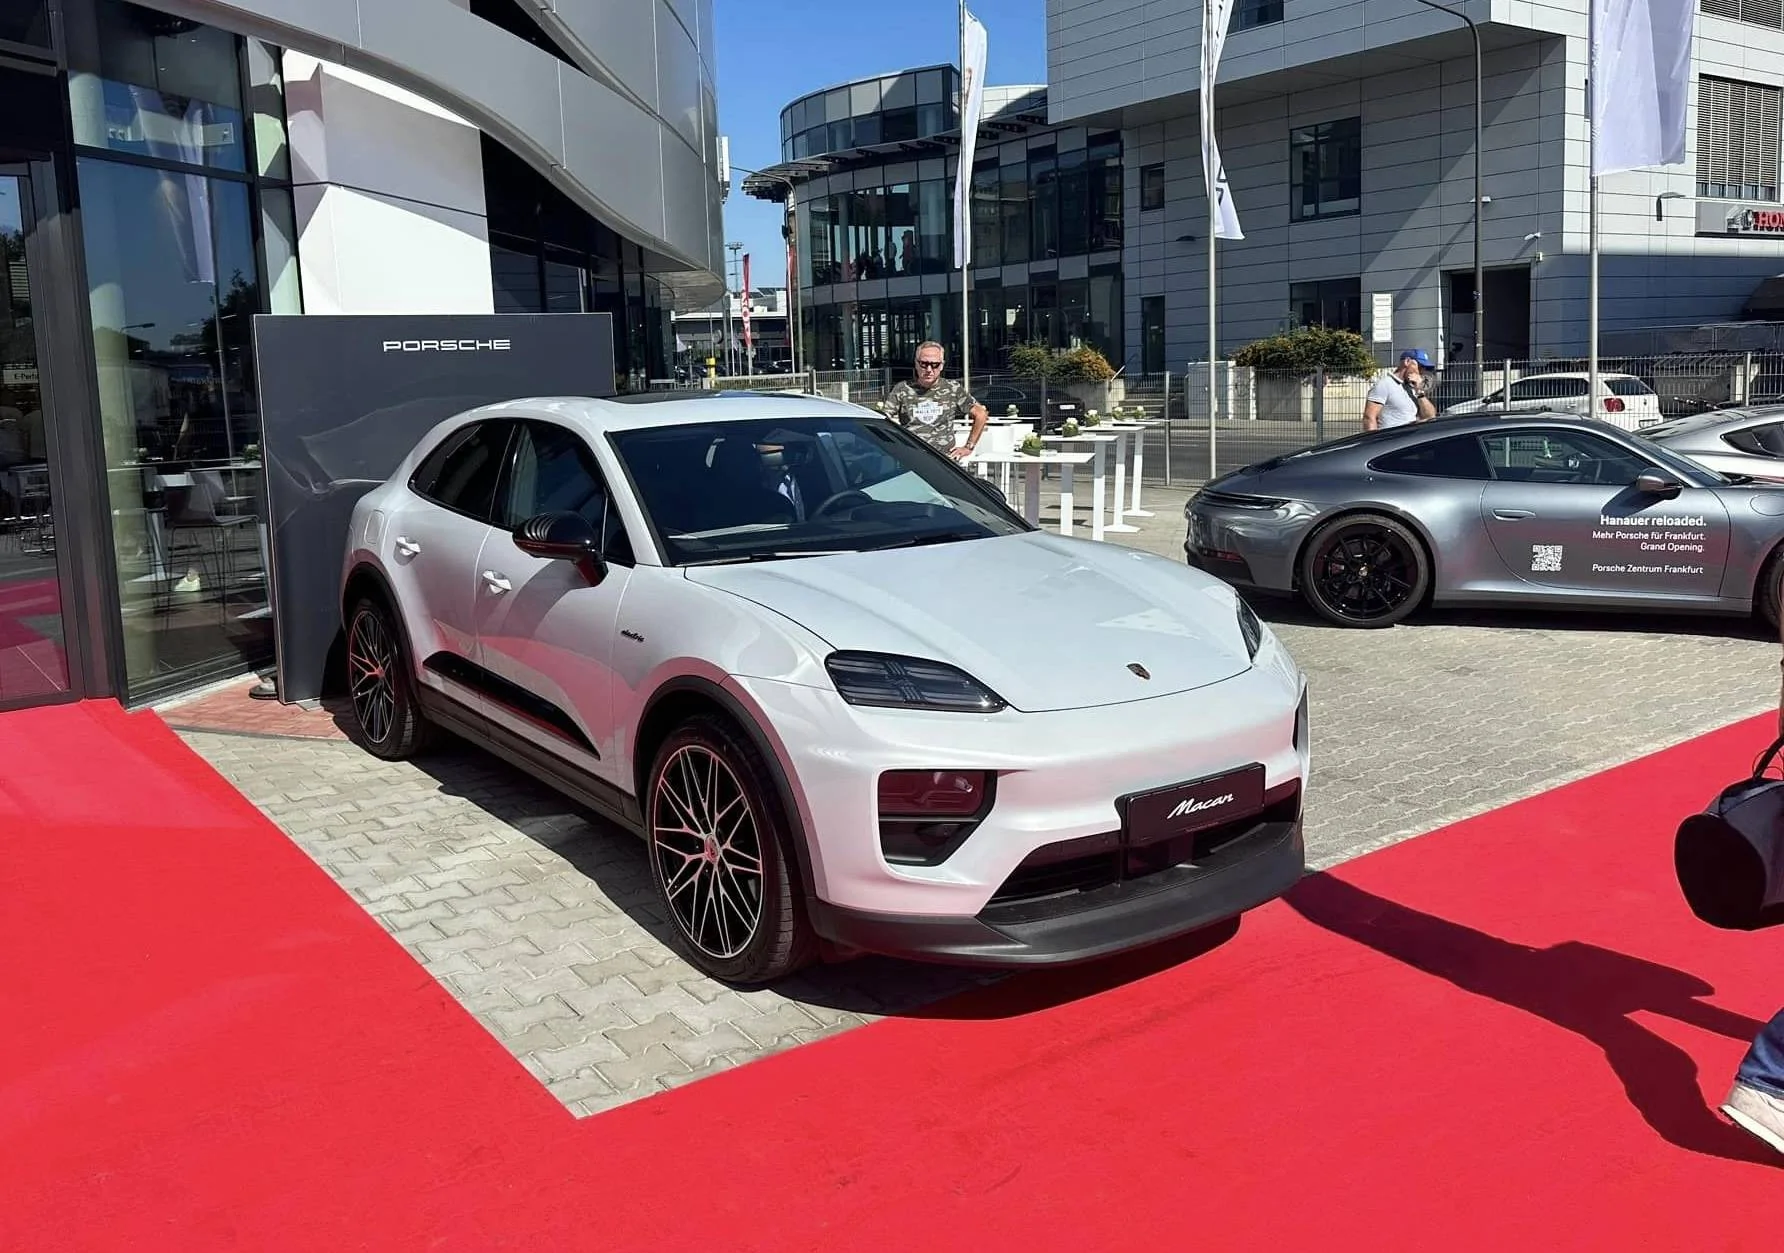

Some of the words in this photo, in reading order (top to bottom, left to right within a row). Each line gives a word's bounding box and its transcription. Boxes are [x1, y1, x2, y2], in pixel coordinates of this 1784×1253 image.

[383, 339, 511, 352] PORSCHE
[1600, 515, 1650, 526] Hanauer
[1652, 515, 1707, 526] reloaded.
[1592, 531, 1613, 539] Mehr
[1616, 531, 1649, 539] Porsche
[1651, 531, 1663, 540] für
[1665, 532, 1706, 540] Frankfurt.
[1640, 542, 1665, 551] Grand
[1668, 543, 1705, 553] Opening.
[1592, 564, 1625, 572] Porsche
[1627, 564, 1662, 573] Zentrum
[1664, 565, 1703, 574] Frankfurt
[1166, 793, 1234, 819] Macan
